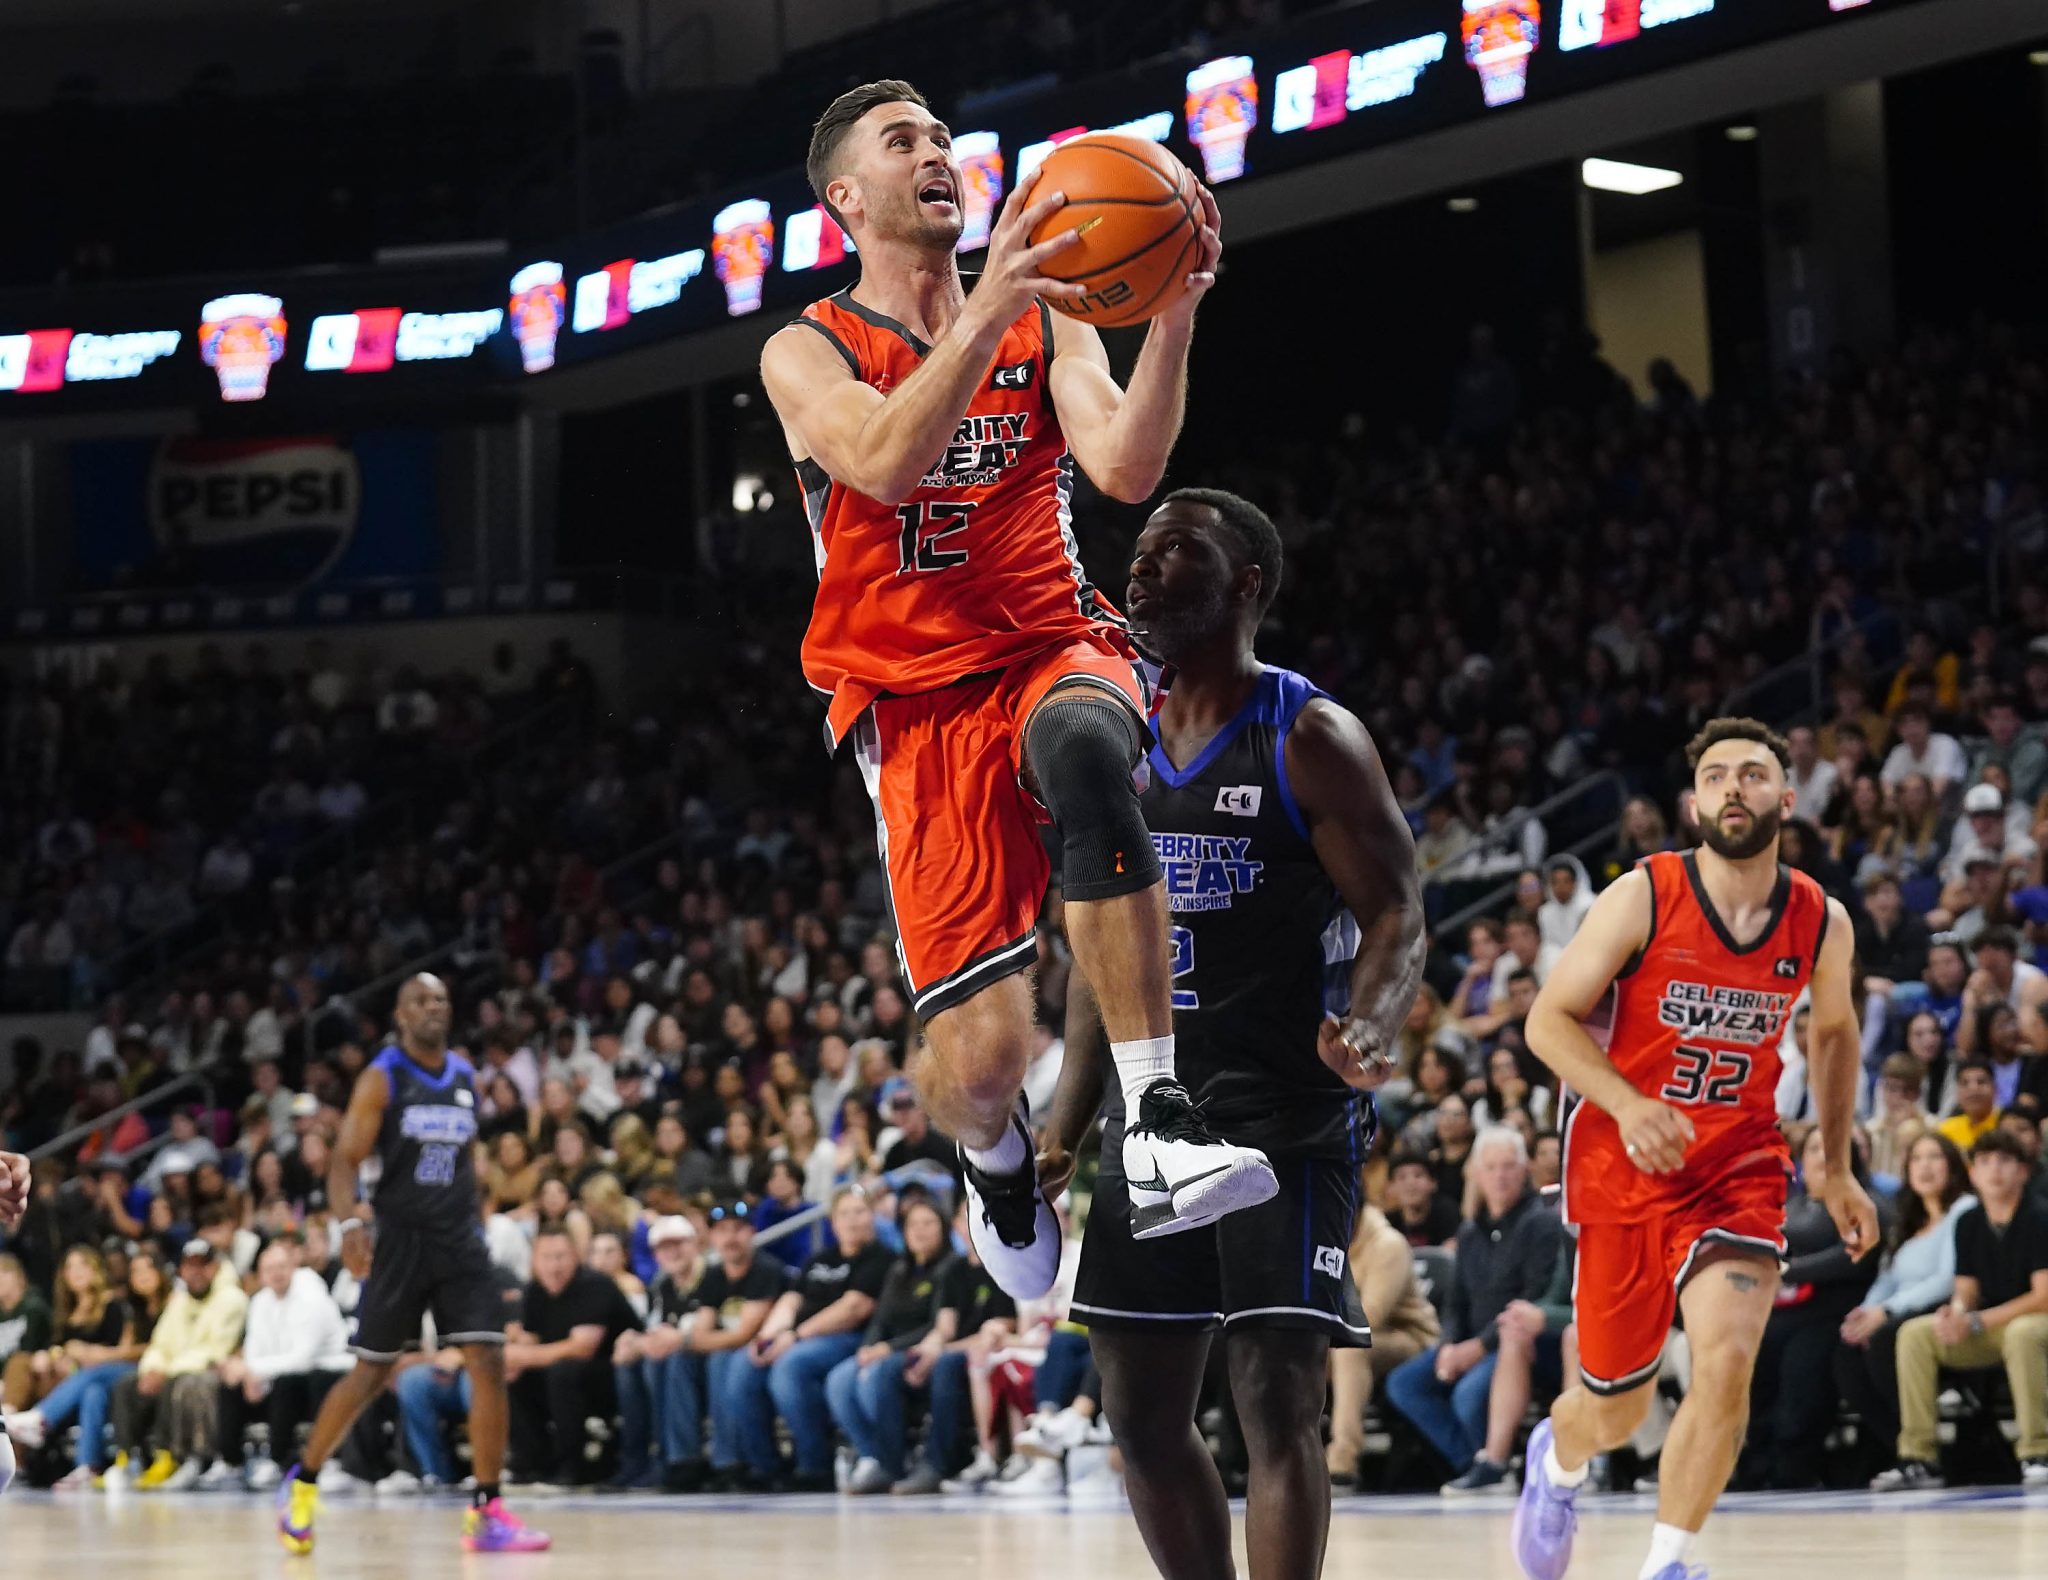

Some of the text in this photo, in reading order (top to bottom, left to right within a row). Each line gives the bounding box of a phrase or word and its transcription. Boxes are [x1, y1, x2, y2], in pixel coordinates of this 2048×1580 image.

[952, 411, 1030, 443] RITY
[925, 438, 1032, 477] EAT
[161, 471, 343, 519] PEPSI
[896, 501, 978, 576] 12
[1160, 860, 1264, 894] EAT
[1172, 894, 1232, 912] & INSPIRE
[1667, 980, 1792, 1011] CELEBRITY
[1659, 997, 1786, 1034] SWEAT
[1660, 1044, 1752, 1107] 32
